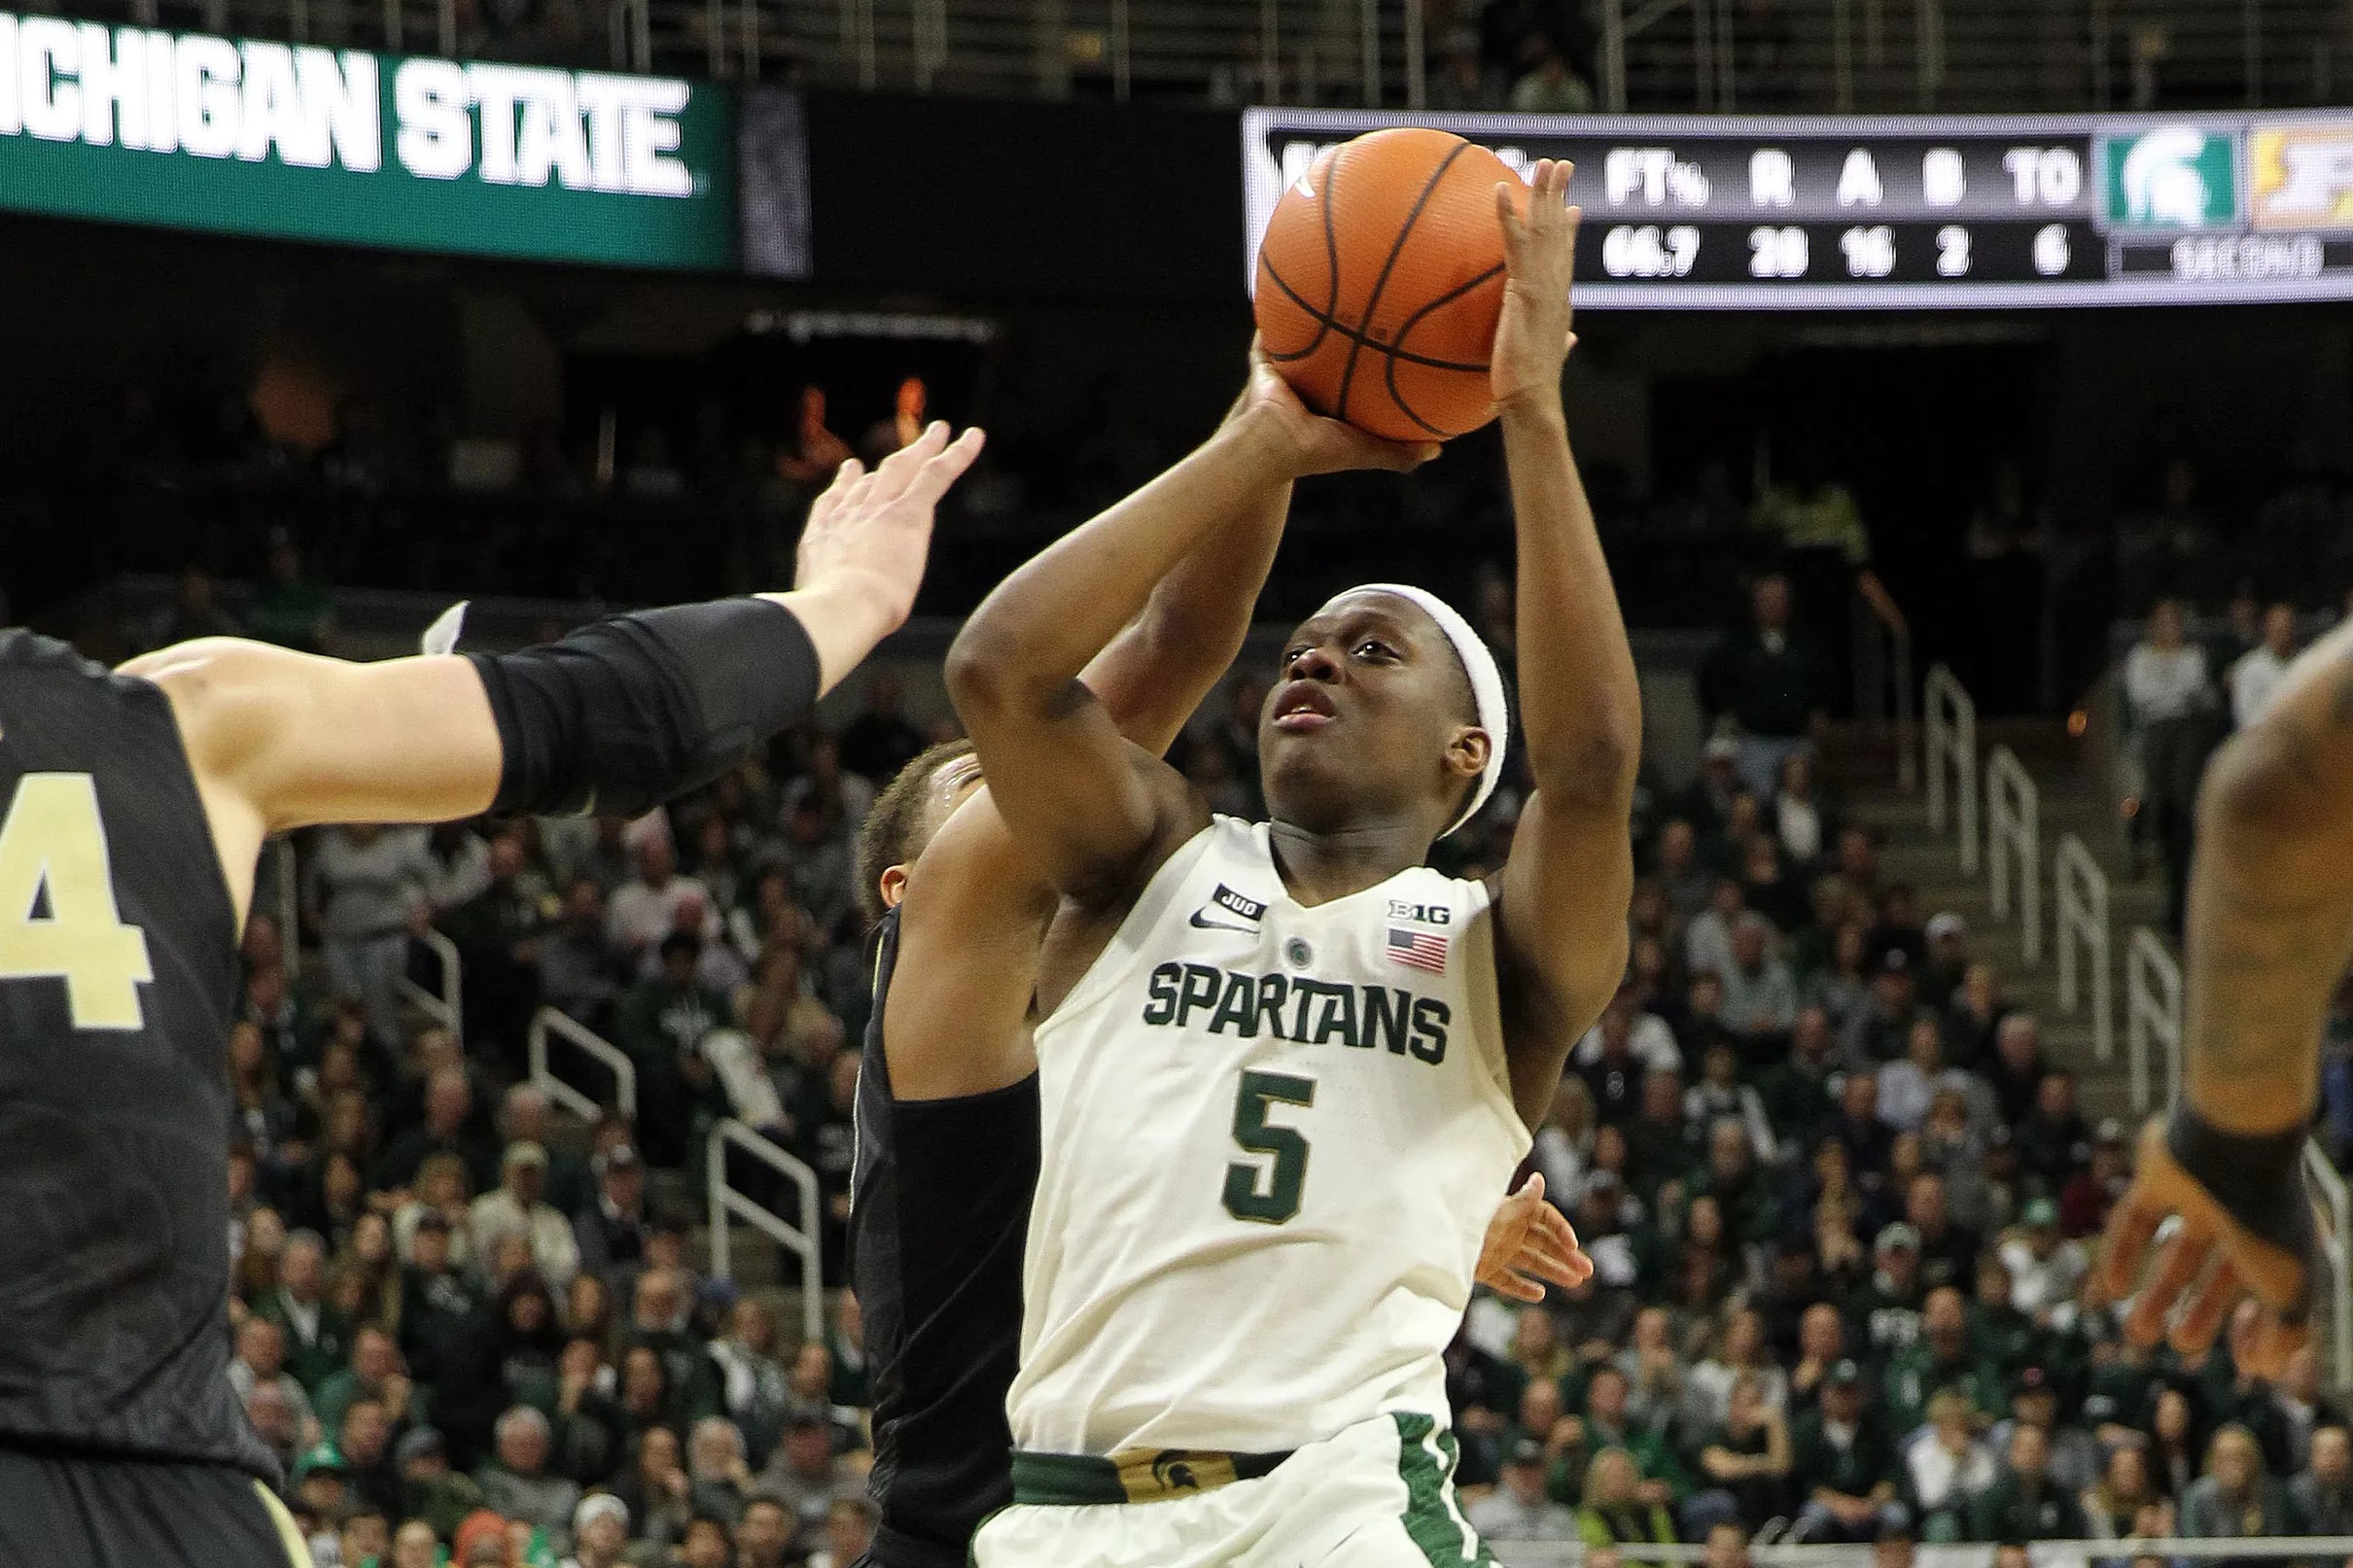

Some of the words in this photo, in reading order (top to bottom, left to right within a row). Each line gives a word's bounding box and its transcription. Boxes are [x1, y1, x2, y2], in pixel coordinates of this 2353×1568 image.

[396, 55, 694, 198] STATE
[1751, 148, 1797, 207] R
[1838, 148, 1883, 207] A
[2003, 146, 2081, 206] TO
[2033, 223, 2071, 276] 6
[0, 772, 154, 1030] 4
[1221, 892, 1258, 916] JUD
[1143, 961, 1450, 1065] SPARTANS
[1222, 1068, 1317, 1225] 5
